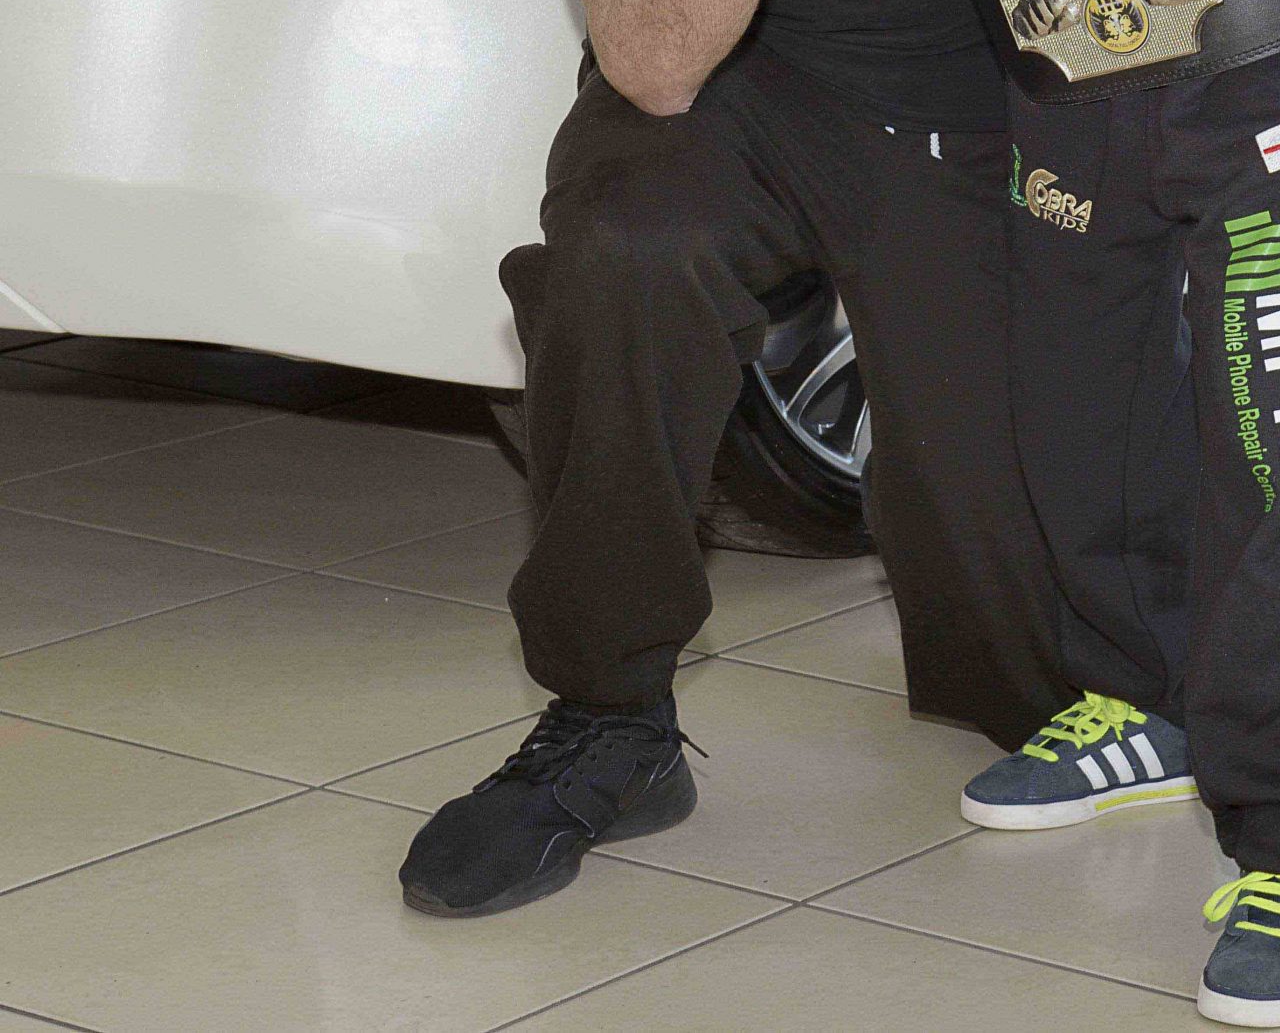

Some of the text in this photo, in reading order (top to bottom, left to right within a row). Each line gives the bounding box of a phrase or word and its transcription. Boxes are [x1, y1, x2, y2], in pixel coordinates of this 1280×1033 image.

[1026, 169, 1093, 221] COBRA
[1043, 209, 1088, 233] KIDS
[1224, 298, 1249, 352] Mobile
[1227, 354, 1253, 406] Phone
[1237, 407, 1268, 460] Repair
